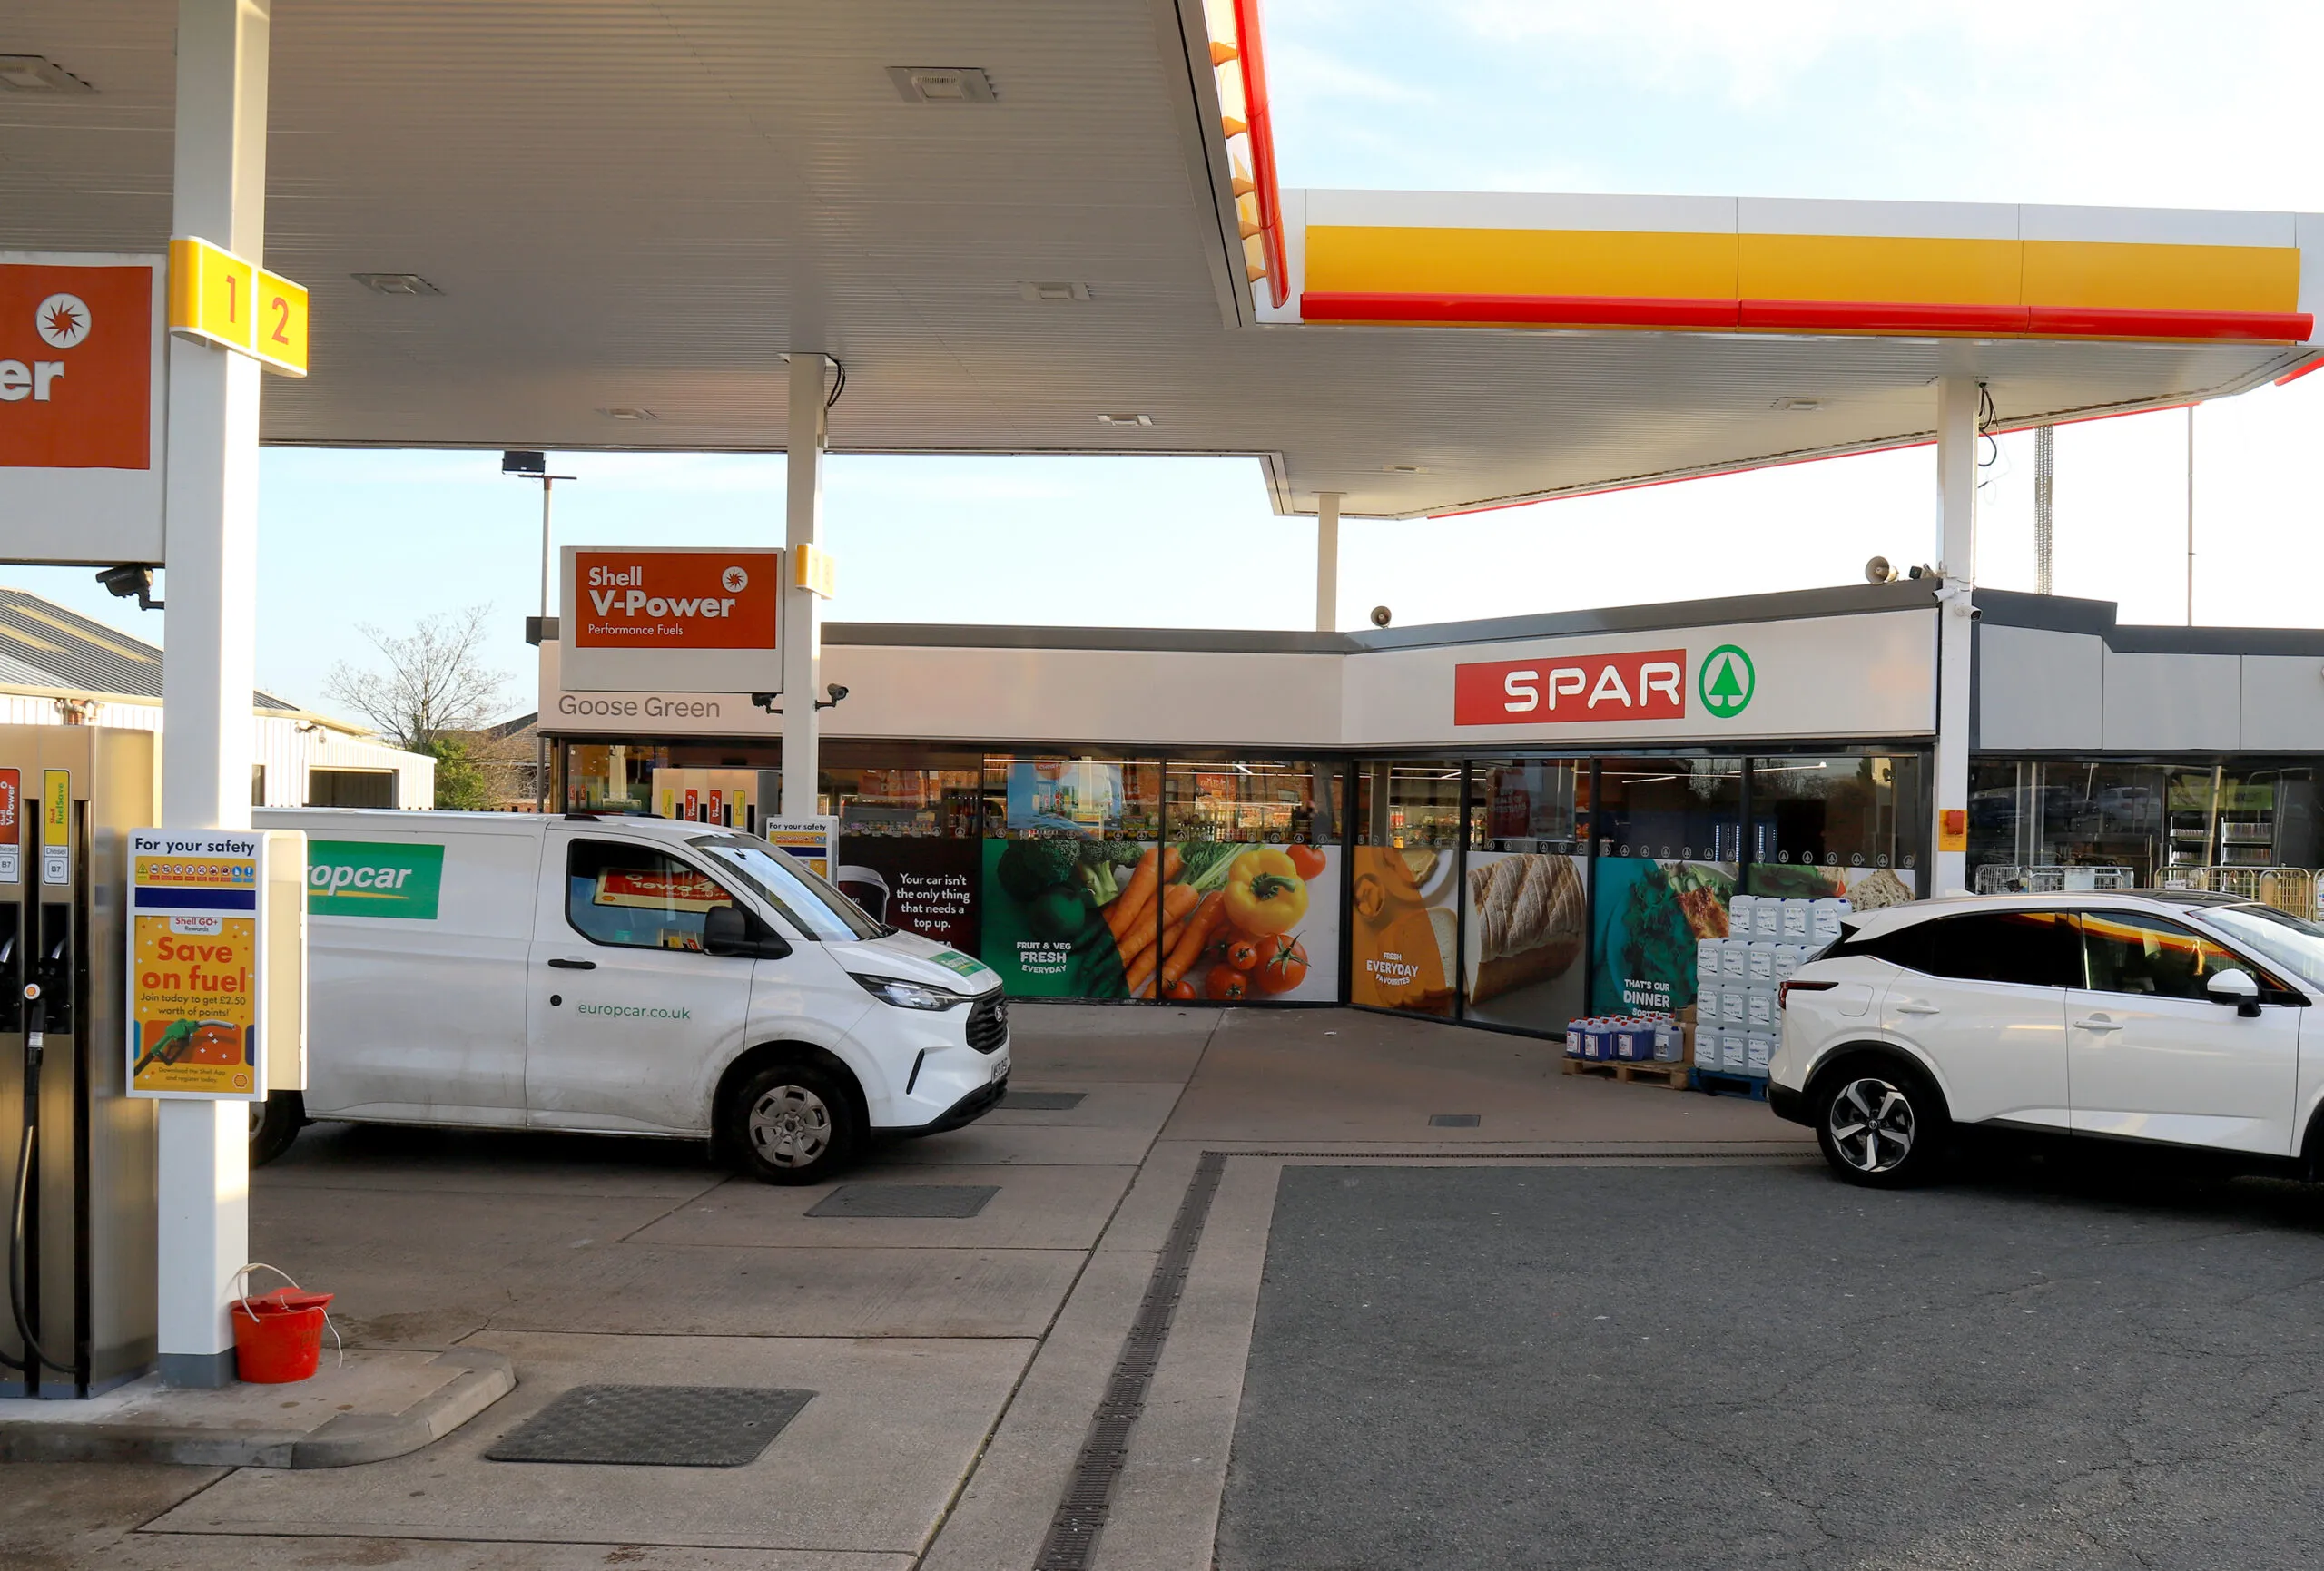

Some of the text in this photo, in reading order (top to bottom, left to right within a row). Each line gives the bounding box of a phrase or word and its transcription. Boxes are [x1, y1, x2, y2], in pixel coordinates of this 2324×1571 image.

[226, 274, 290, 346] 1 2
[588, 565, 642, 586] Shell
[588, 590, 735, 618] V-Power
[588, 623, 684, 635] Performance Fuels
[1504, 662, 1681, 712] SPAR
[559, 695, 720, 718] Goose Green
[6, 785, 15, 825] V-Power
[56, 782, 64, 824] FuelSave
[803, 823, 826, 831] safety
[135, 838, 255, 856] For your safety
[900, 873, 924, 884] Your
[945, 874, 967, 885] isn't
[896, 887, 970, 904] the only thing
[901, 901, 923, 913] that
[926, 903, 957, 914] needs
[175, 917, 218, 926] Shell GO+
[914, 918, 951, 932] top up.
[157, 936, 232, 963] Save
[1017, 941, 1040, 949] FRUIT
[1053, 942, 1071, 950] VEG
[1020, 951, 1067, 963] FRESH
[1383, 952, 1402, 961] FRESH
[1021, 964, 1067, 974] EVERYDAY
[1366, 959, 1419, 977] EVERYDAY
[142, 965, 246, 993] on fuel
[1375, 973, 1410, 986] FAVOURITES
[1624, 978, 1670, 992] THAT'S OUR
[141, 993, 160, 1001] Join
[162, 994, 189, 1004] today
[203, 997, 218, 1006] get
[220, 996, 246, 1006] £2.50
[1623, 990, 1670, 1008] DINNER
[158, 1006, 185, 1015] worth
[188, 1007, 196, 1016] of
[578, 1002, 691, 1020] europcar.co.uk
[1631, 1007, 1660, 1016] SORTD
